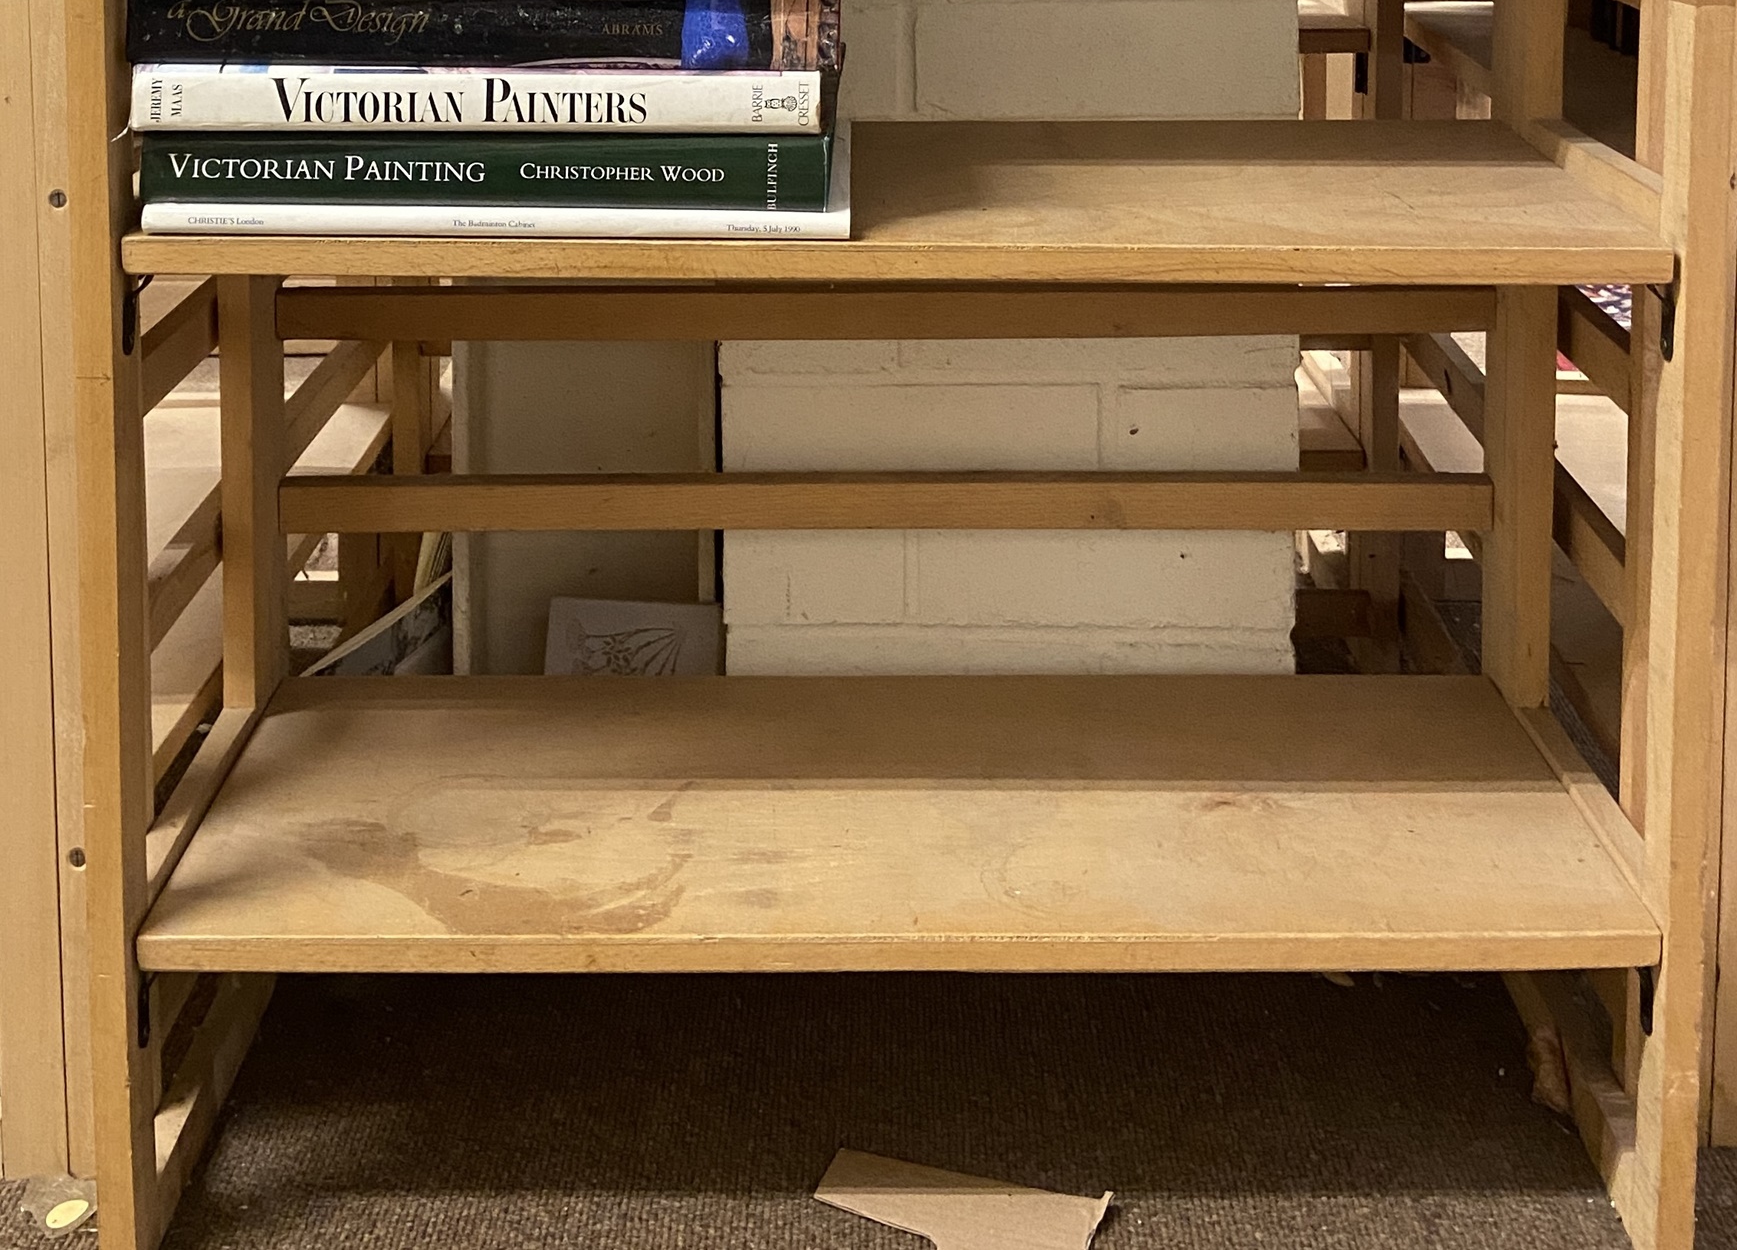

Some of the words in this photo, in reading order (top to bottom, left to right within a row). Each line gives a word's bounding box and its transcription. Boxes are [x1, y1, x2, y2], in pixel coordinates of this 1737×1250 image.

[602, 23, 663, 36] ABRAMS
[150, 77, 163, 123] JEREMY
[170, 83, 184, 117] MAAS
[272, 78, 465, 123] VICTORIAN
[482, 77, 648, 124] PAINTERS
[751, 82, 764, 123] BARRIE
[797, 81, 810, 126] CRESSET
[168, 152, 335, 180] VICTORIAN
[343, 155, 485, 182] PAINTING
[519, 162, 654, 182] CHRISTOPHER
[660, 165, 725, 182] WOOD
[766, 143, 778, 210] BULFINCH
[187, 216, 235, 225] CHRISTIE'S
[236, 217, 265, 225] London
[453, 219, 466, 227] The
[768, 225, 782, 233] July
[785, 225, 801, 233] 1990
